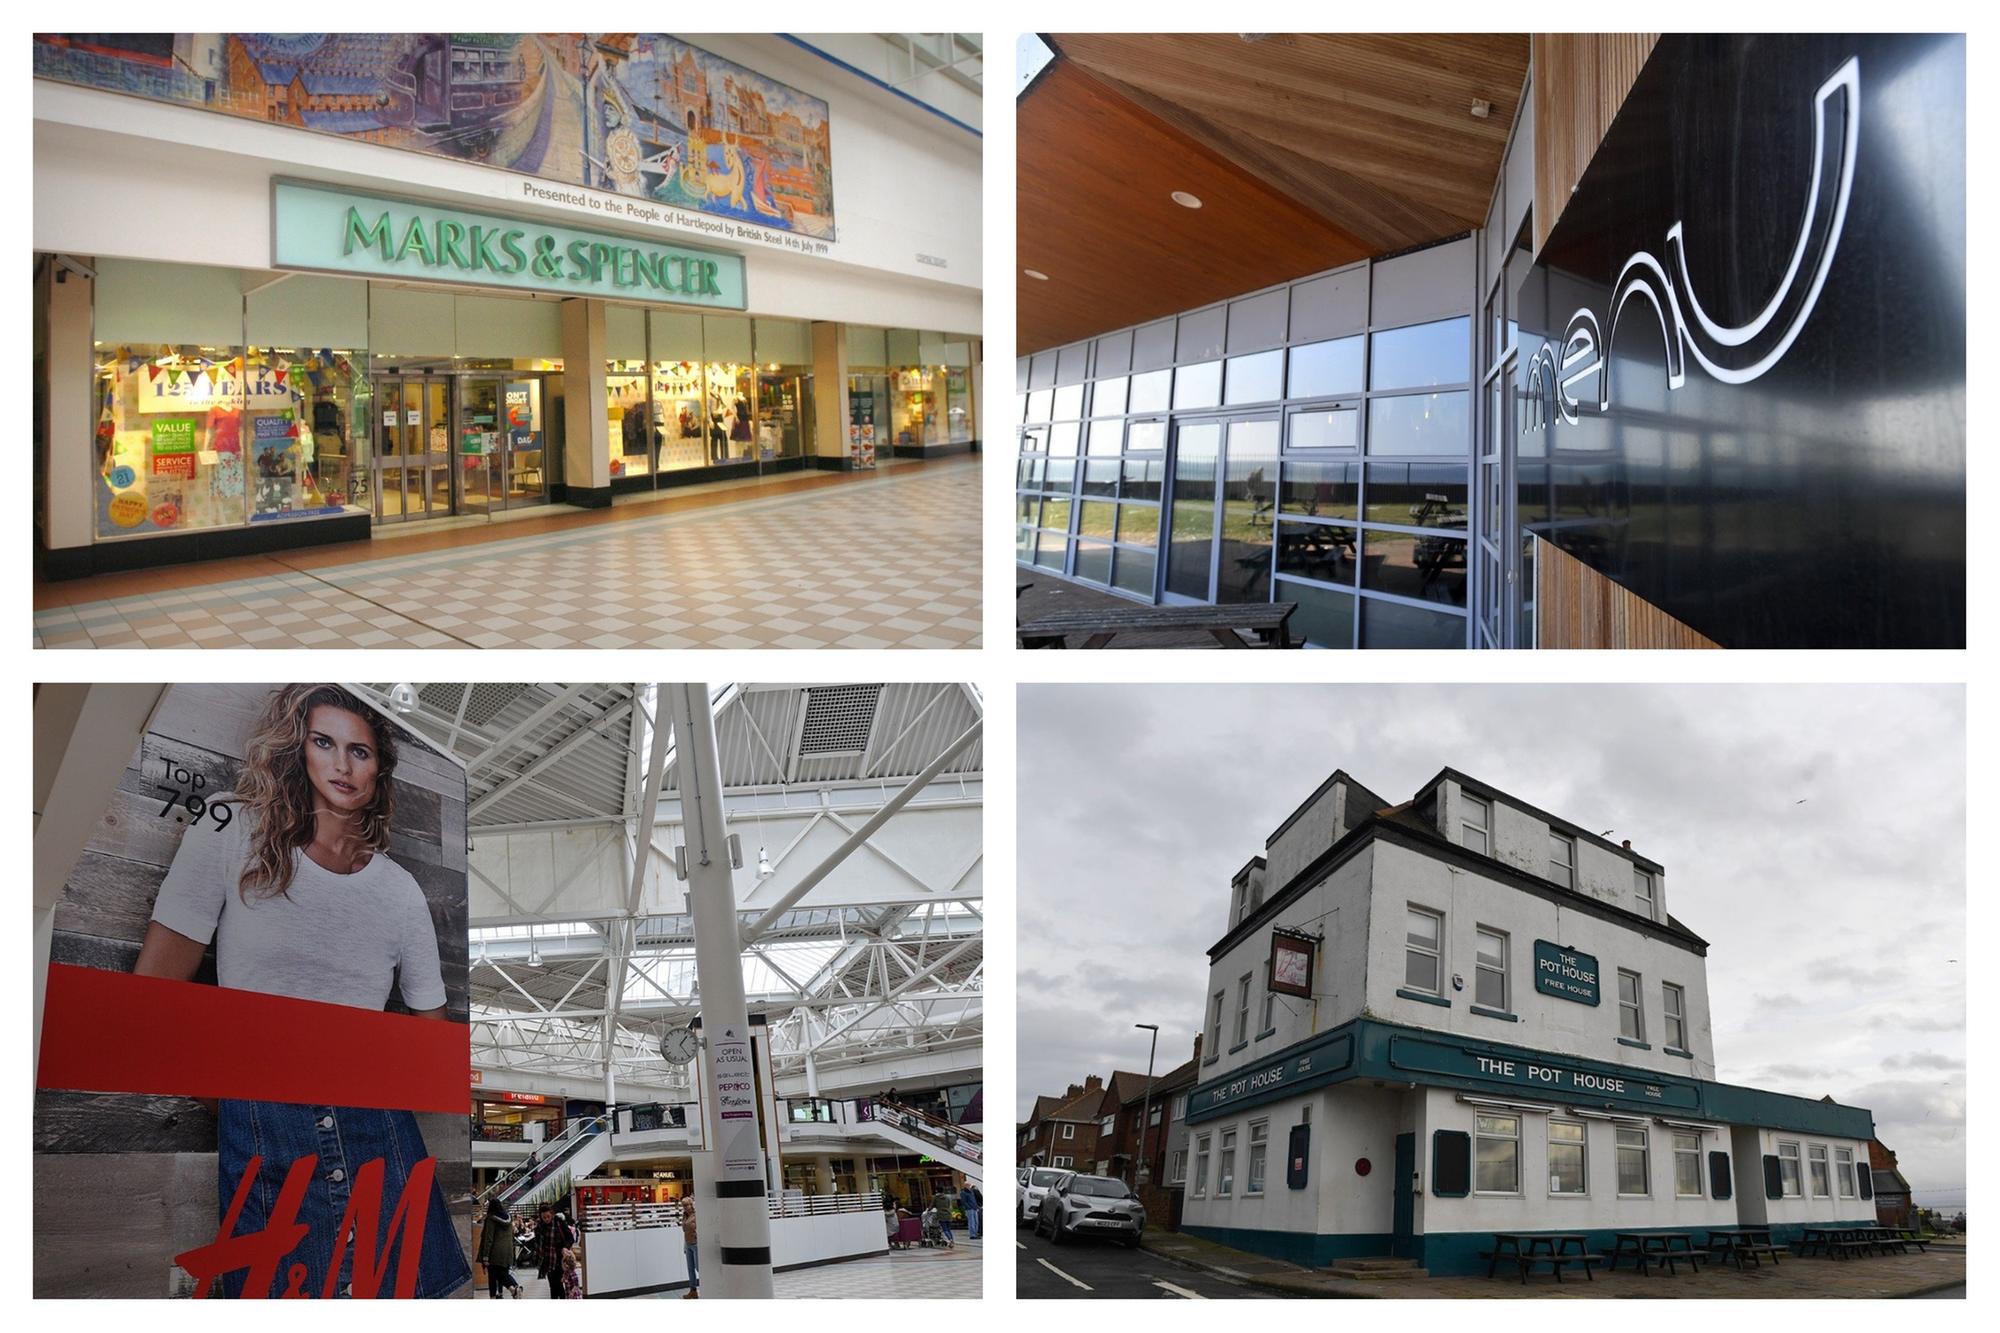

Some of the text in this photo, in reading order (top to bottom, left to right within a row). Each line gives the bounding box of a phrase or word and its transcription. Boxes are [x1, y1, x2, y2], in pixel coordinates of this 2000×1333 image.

[523, 182, 586, 207] Presented
[588, 198, 601, 210] to
[605, 201, 623, 214] the
[627, 203, 660, 222] People
[664, 212, 674, 224] of
[676, 212, 723, 232] Hartlepool
[725, 223, 735, 238] by
[737, 226, 762, 241] British
[764, 231, 782, 245] Steel
[801, 241, 814, 254] July
[343, 205, 722, 296] MARKS & SPENCER
[1522, 55, 1860, 436] menu
[156, 423, 192, 433] VALUE
[156, 456, 192, 467] SERVICE
[160, 756, 206, 790] Top
[156, 785, 233, 833] 7.99
[1540, 958, 1596, 985] POT HOUSE
[1560, 953, 1577, 967] THE
[1544, 978, 1593, 998] FREE HOUSE
[716, 1056, 725, 1064] AS
[721, 1048, 743, 1056] OPEN
[1212, 1066, 1284, 1102] THE POT HOUSE
[1476, 1057, 1625, 1094] THE POT HOUSE
[174, 1153, 436, 1299] H&M
